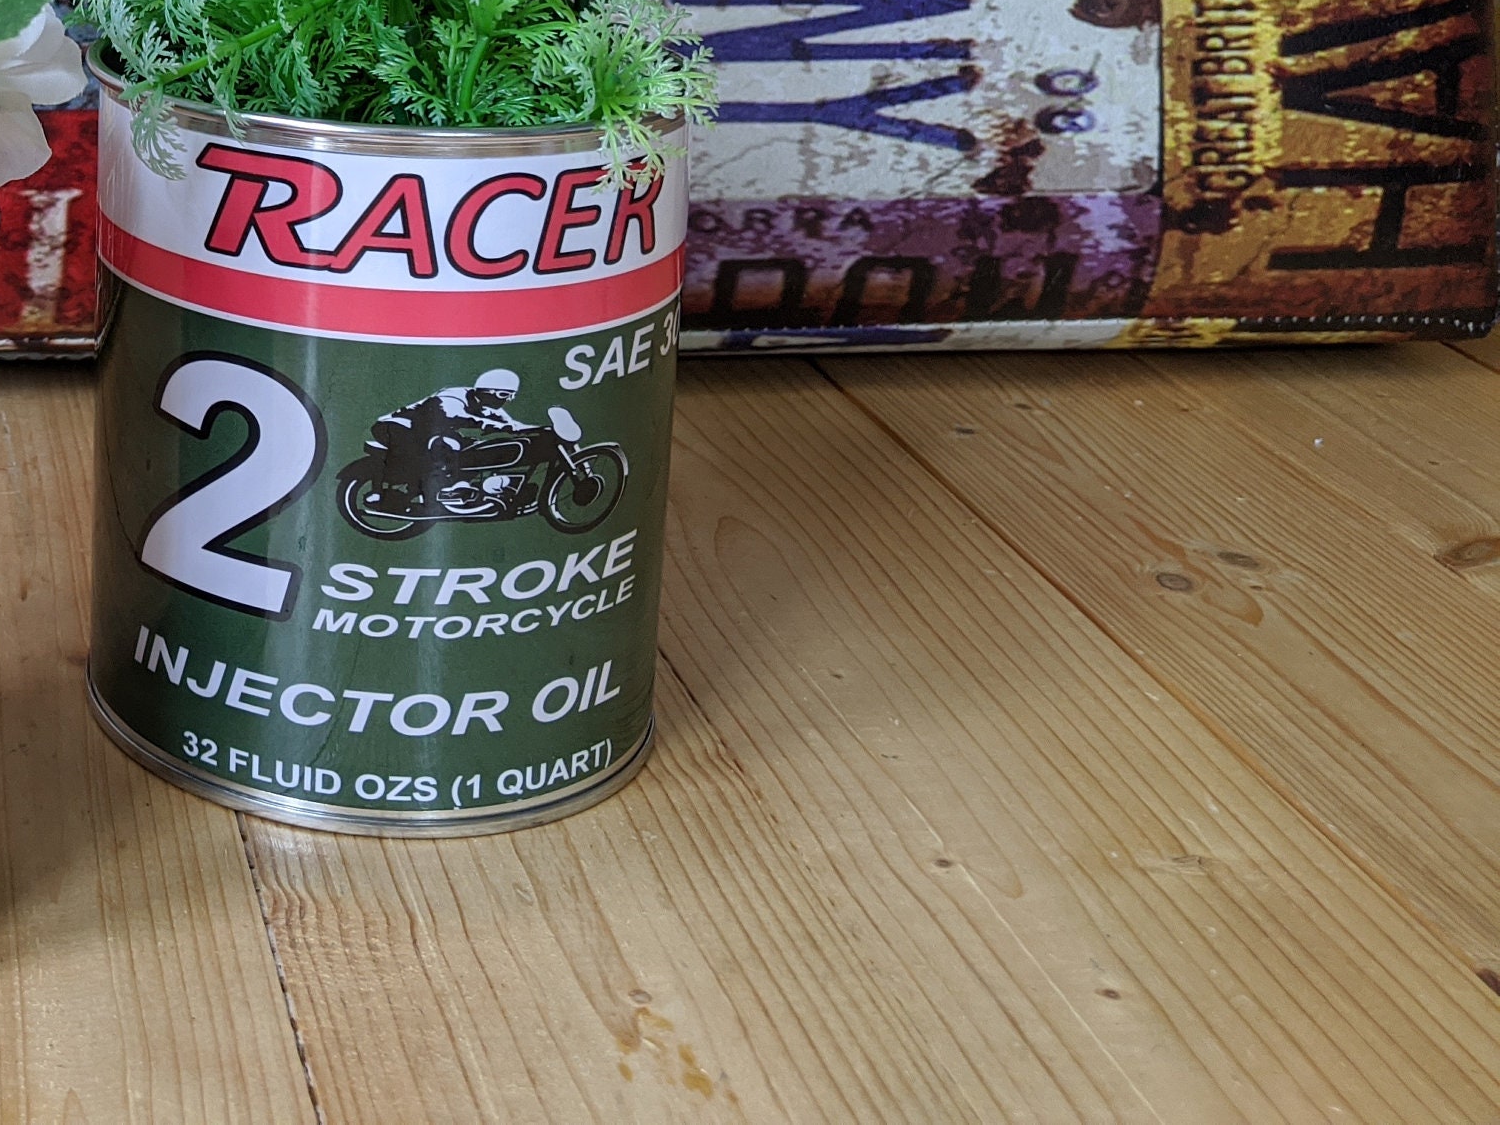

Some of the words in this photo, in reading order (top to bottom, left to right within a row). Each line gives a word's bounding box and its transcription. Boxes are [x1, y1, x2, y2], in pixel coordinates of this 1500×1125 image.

[1192, 81, 1257, 194] GREAT
[196, 142, 664, 279] RACER
[559, 322, 655, 390] SAE
[138, 350, 328, 622] 2
[311, 574, 636, 640] MOTORCYCLE
[320, 529, 638, 606] STROKE
[133, 625, 510, 737] INJECTOR
[531, 659, 622, 724] OIL
[182, 730, 218, 767] 32
[228, 745, 342, 796] FLUID
[354, 773, 438, 803] OZS
[450, 772, 482, 808] (1
[496, 737, 614, 798] QUART)
